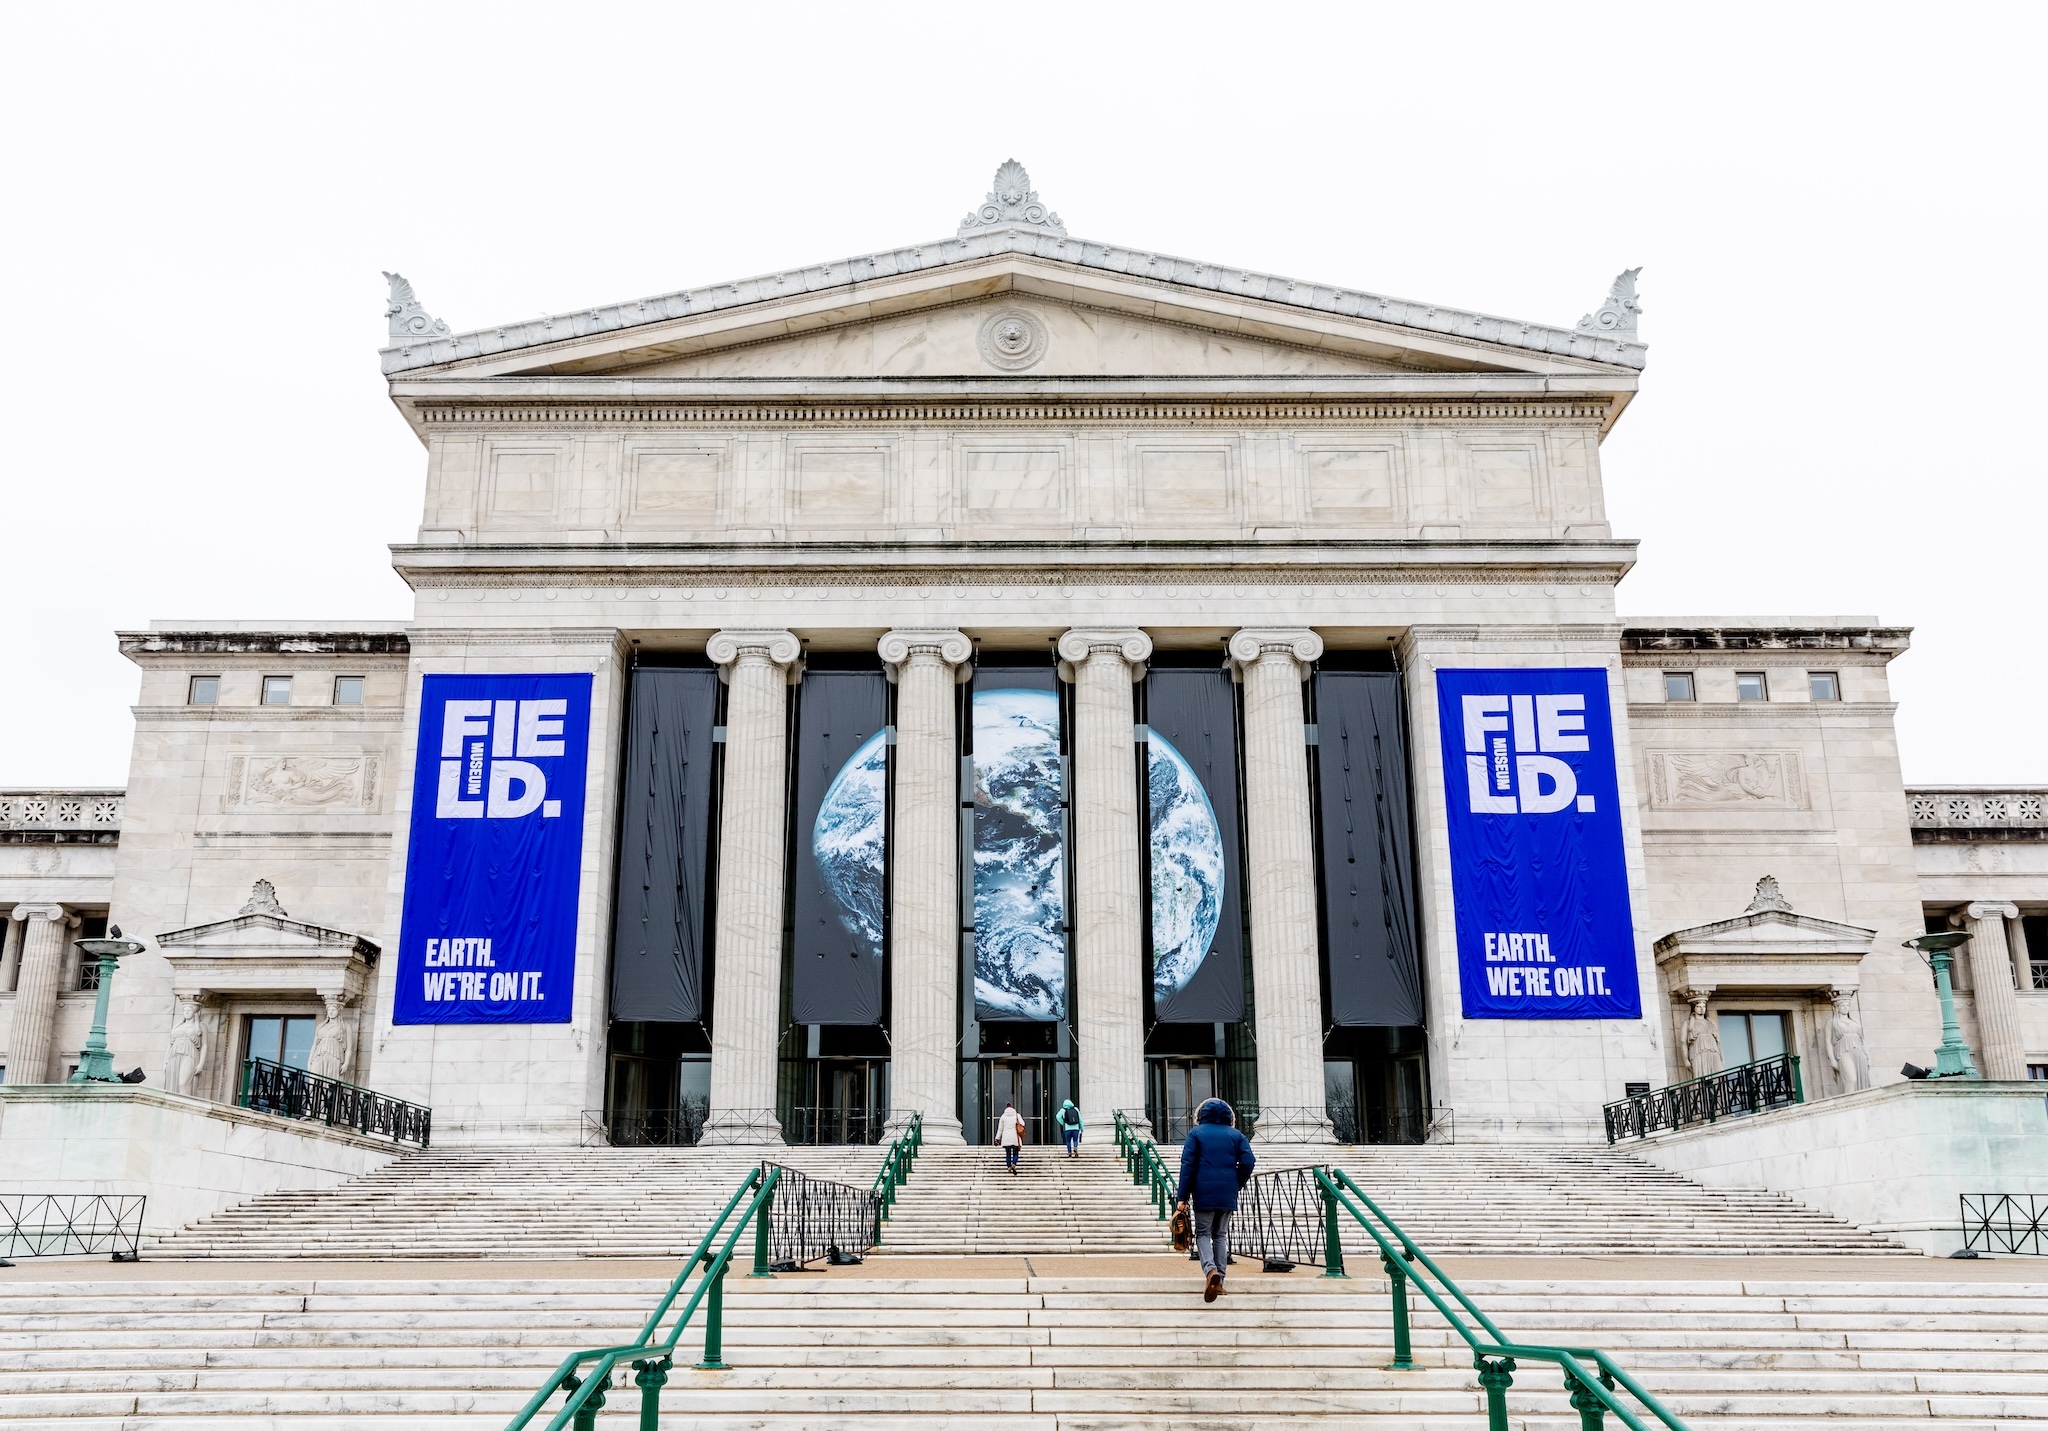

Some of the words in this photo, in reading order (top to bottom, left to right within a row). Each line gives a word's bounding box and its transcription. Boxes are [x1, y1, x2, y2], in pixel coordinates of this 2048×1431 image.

[467, 742, 485, 794] MUSEUM
[1492, 737, 1510, 790] MUSEUM
[425, 938, 496, 967] EARTH.
[1484, 932, 1556, 963] EARTH.
[423, 972, 486, 1001] WE'RE
[489, 972, 518, 1001] ON
[520, 972, 545, 1001] IT.
[1486, 966, 1552, 997] WE'RE
[1554, 966, 1585, 997] ON
[1585, 966, 1612, 996] IT.
